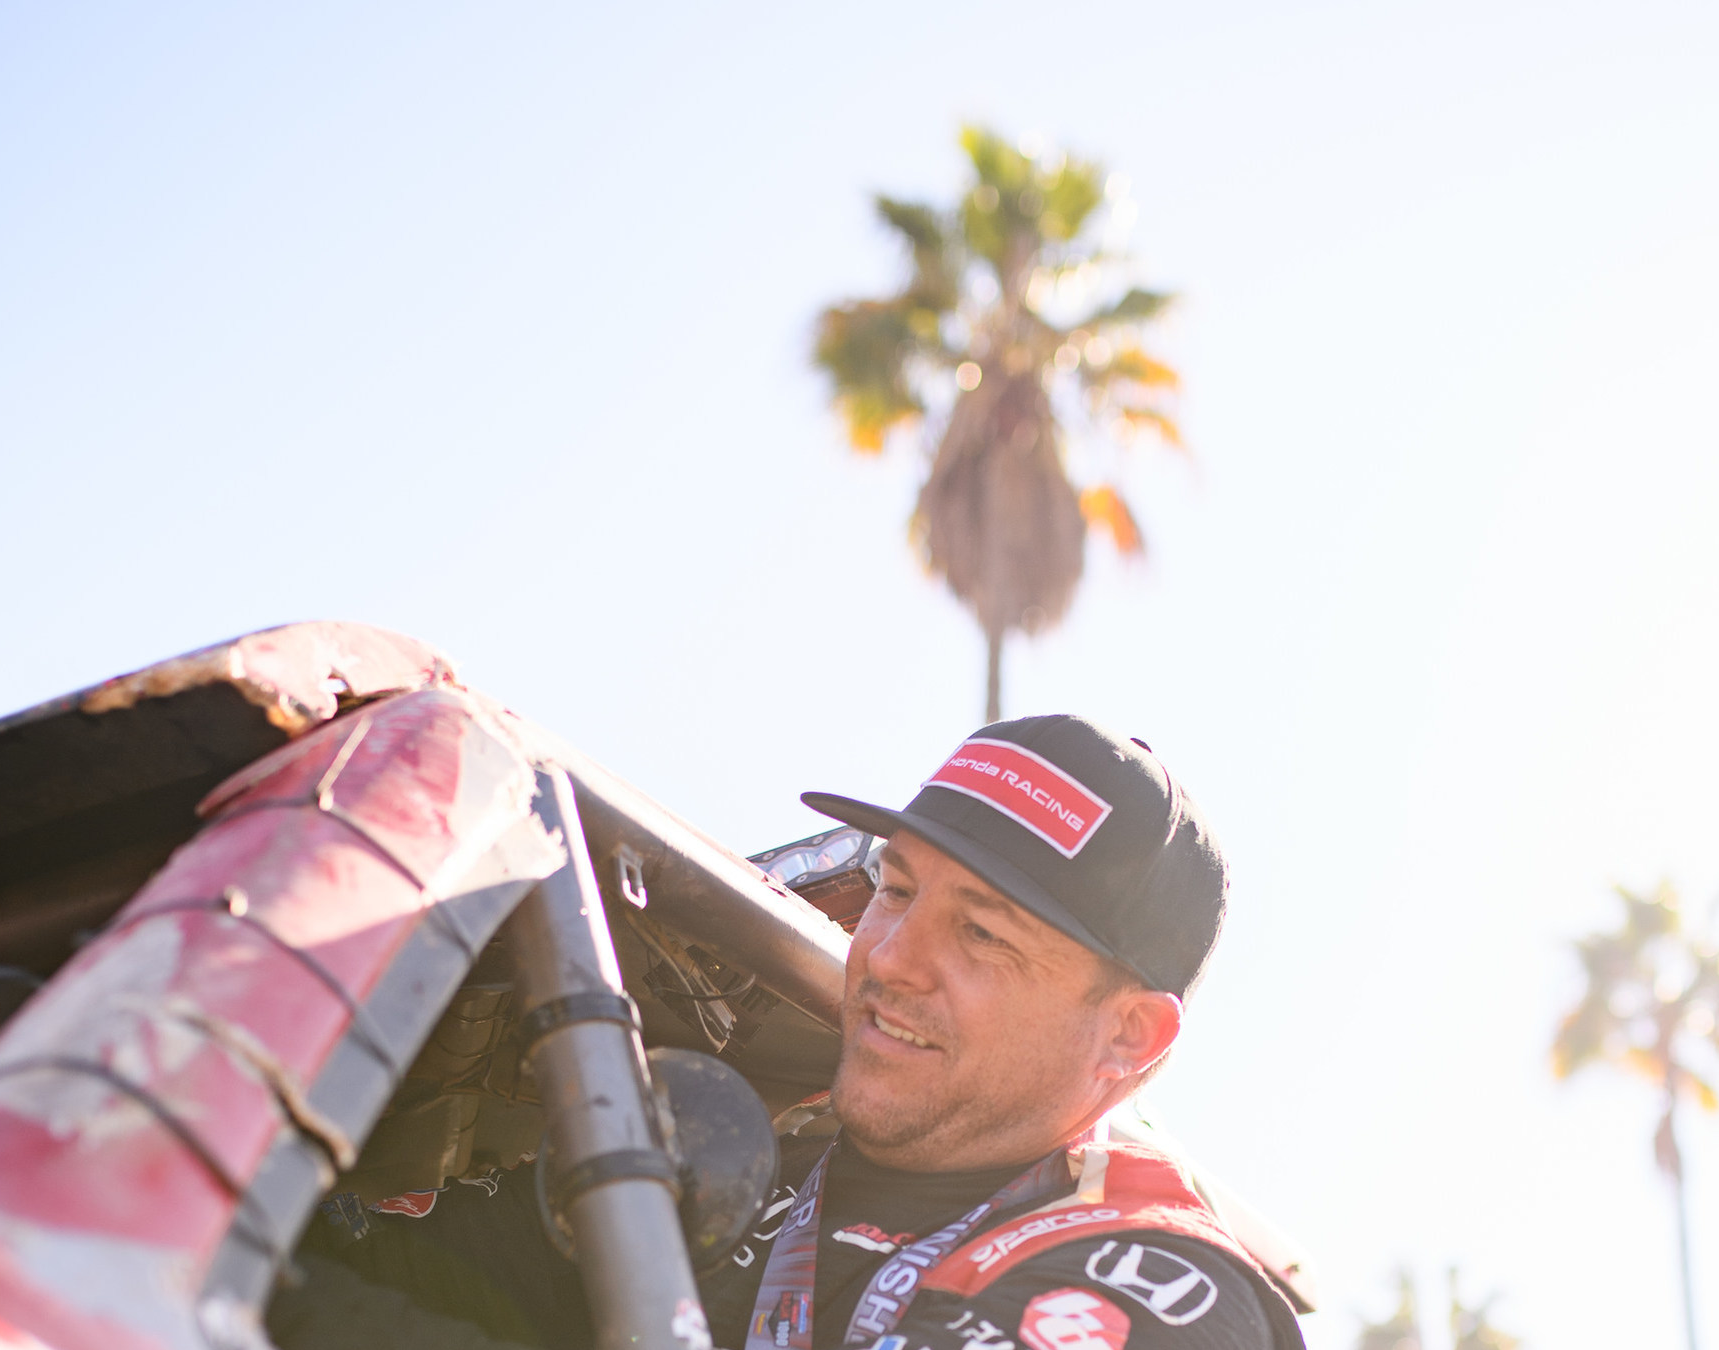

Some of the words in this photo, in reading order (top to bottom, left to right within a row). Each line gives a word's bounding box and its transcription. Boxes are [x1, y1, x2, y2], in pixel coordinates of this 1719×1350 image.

[946, 757, 1000, 778] Honda
[1000, 769, 1085, 833] RACING
[849, 1203, 991, 1342] FINISH
[969, 1208, 1120, 1273] sparco
